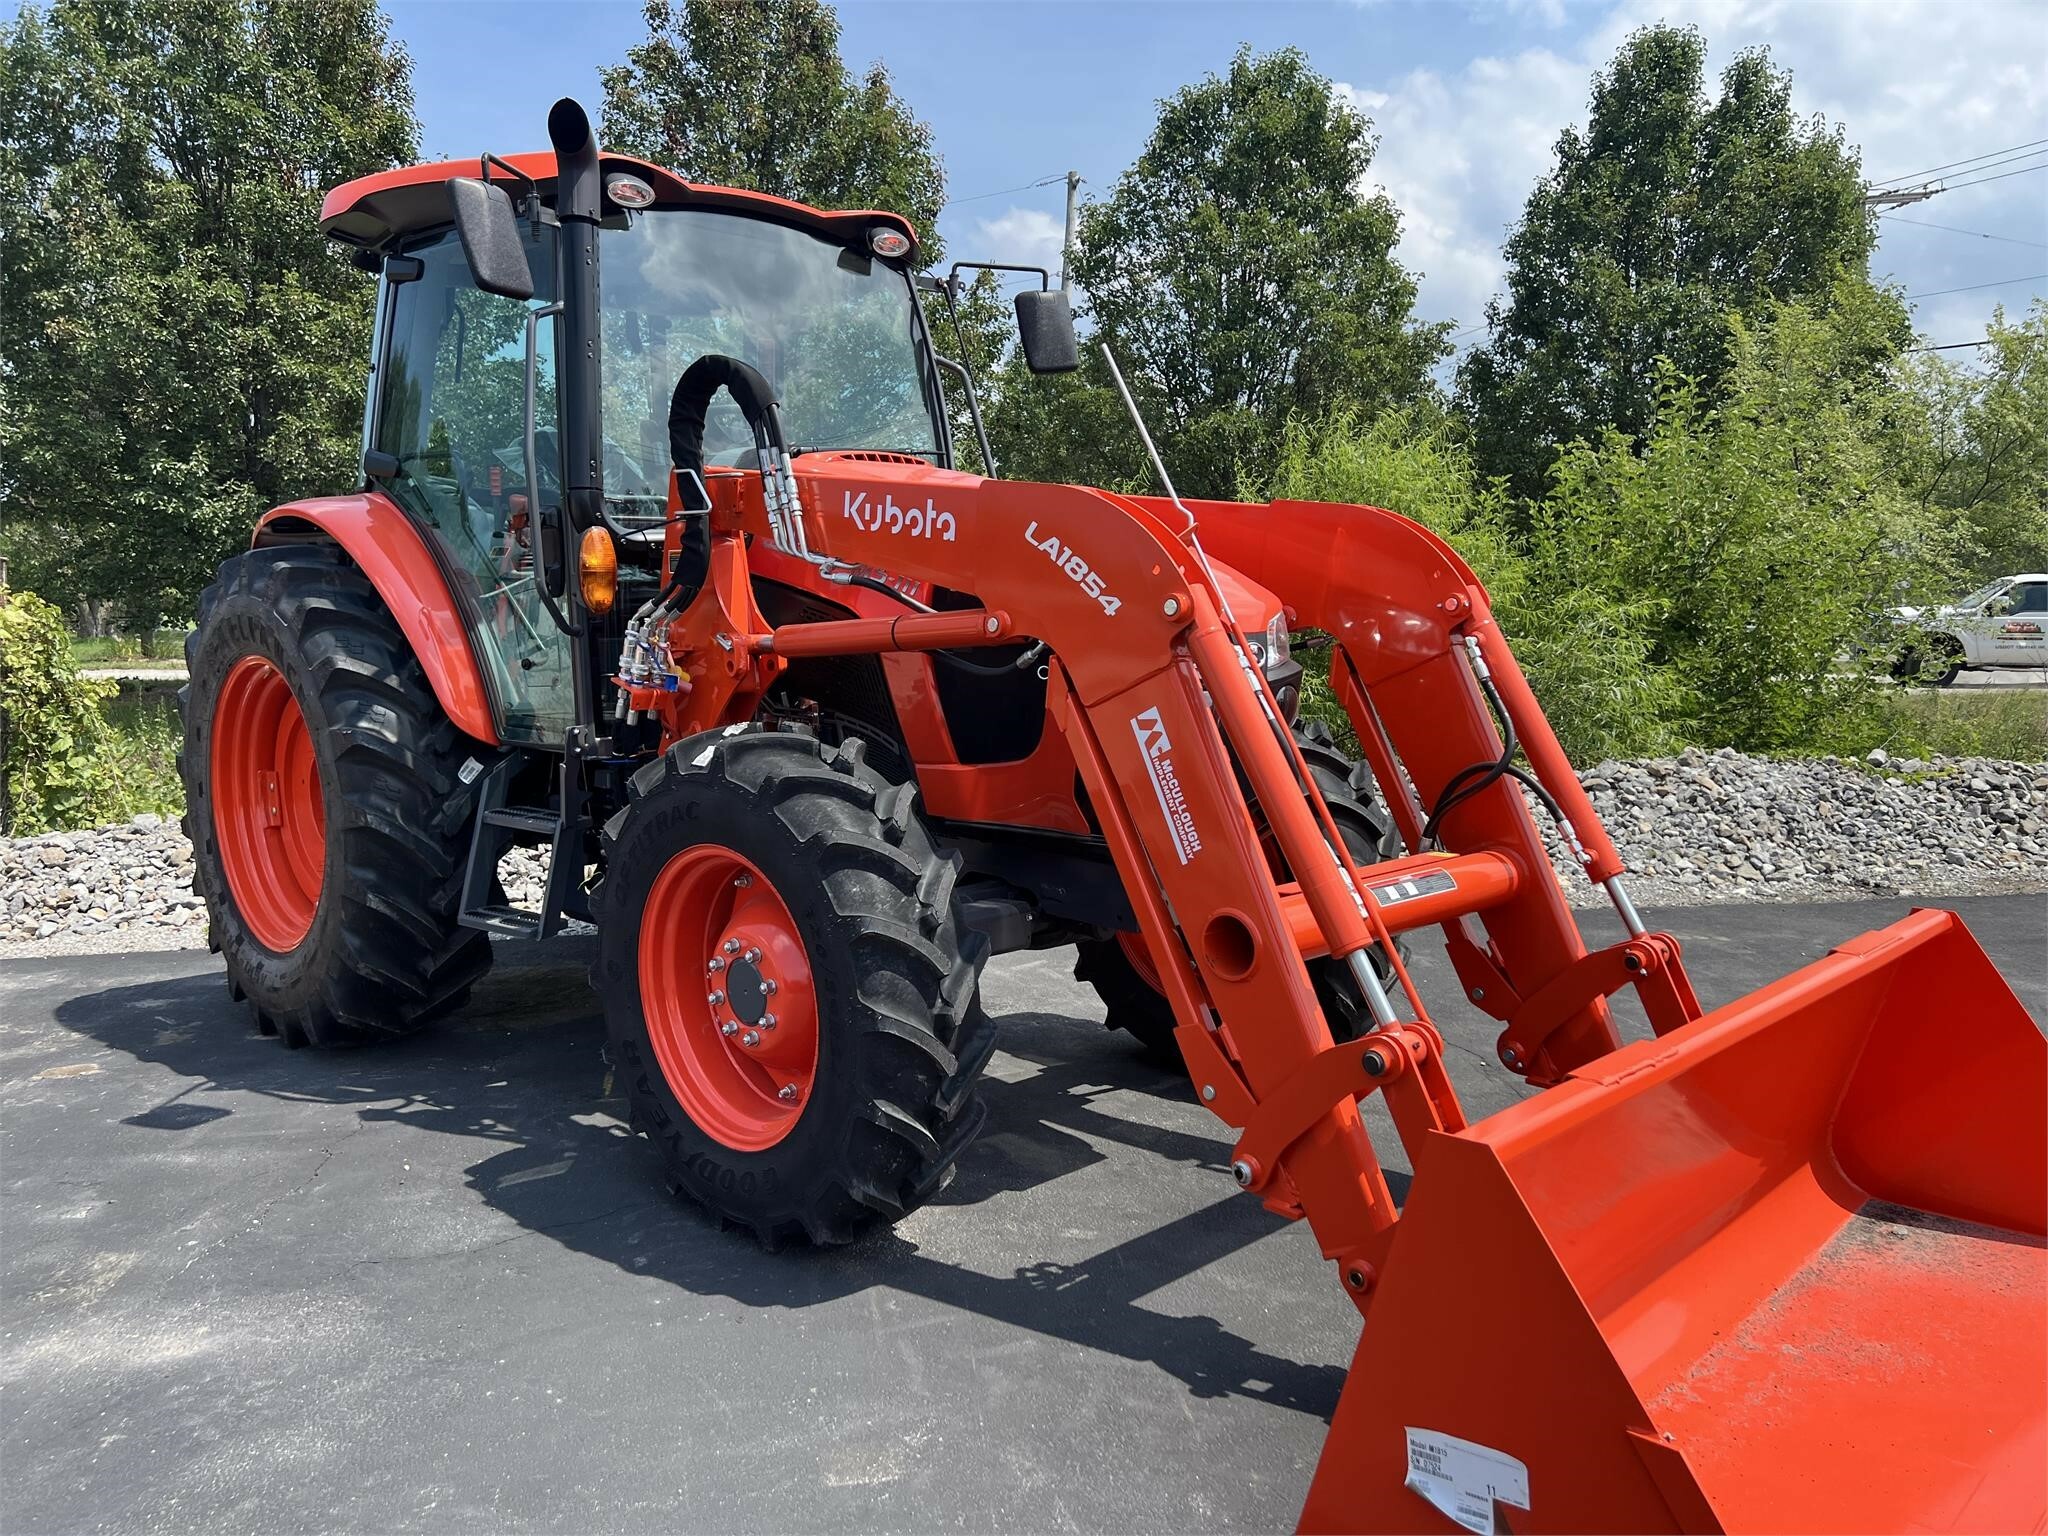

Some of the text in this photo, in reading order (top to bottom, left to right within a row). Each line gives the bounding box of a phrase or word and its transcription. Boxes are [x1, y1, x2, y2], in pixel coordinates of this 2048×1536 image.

[843, 490, 957, 543] Kubota
[1023, 520, 1123, 617] LA1854
[1152, 758, 1195, 860] IMPLEMENT COMPANY
[1161, 758, 1203, 853] McCULLOUGH
